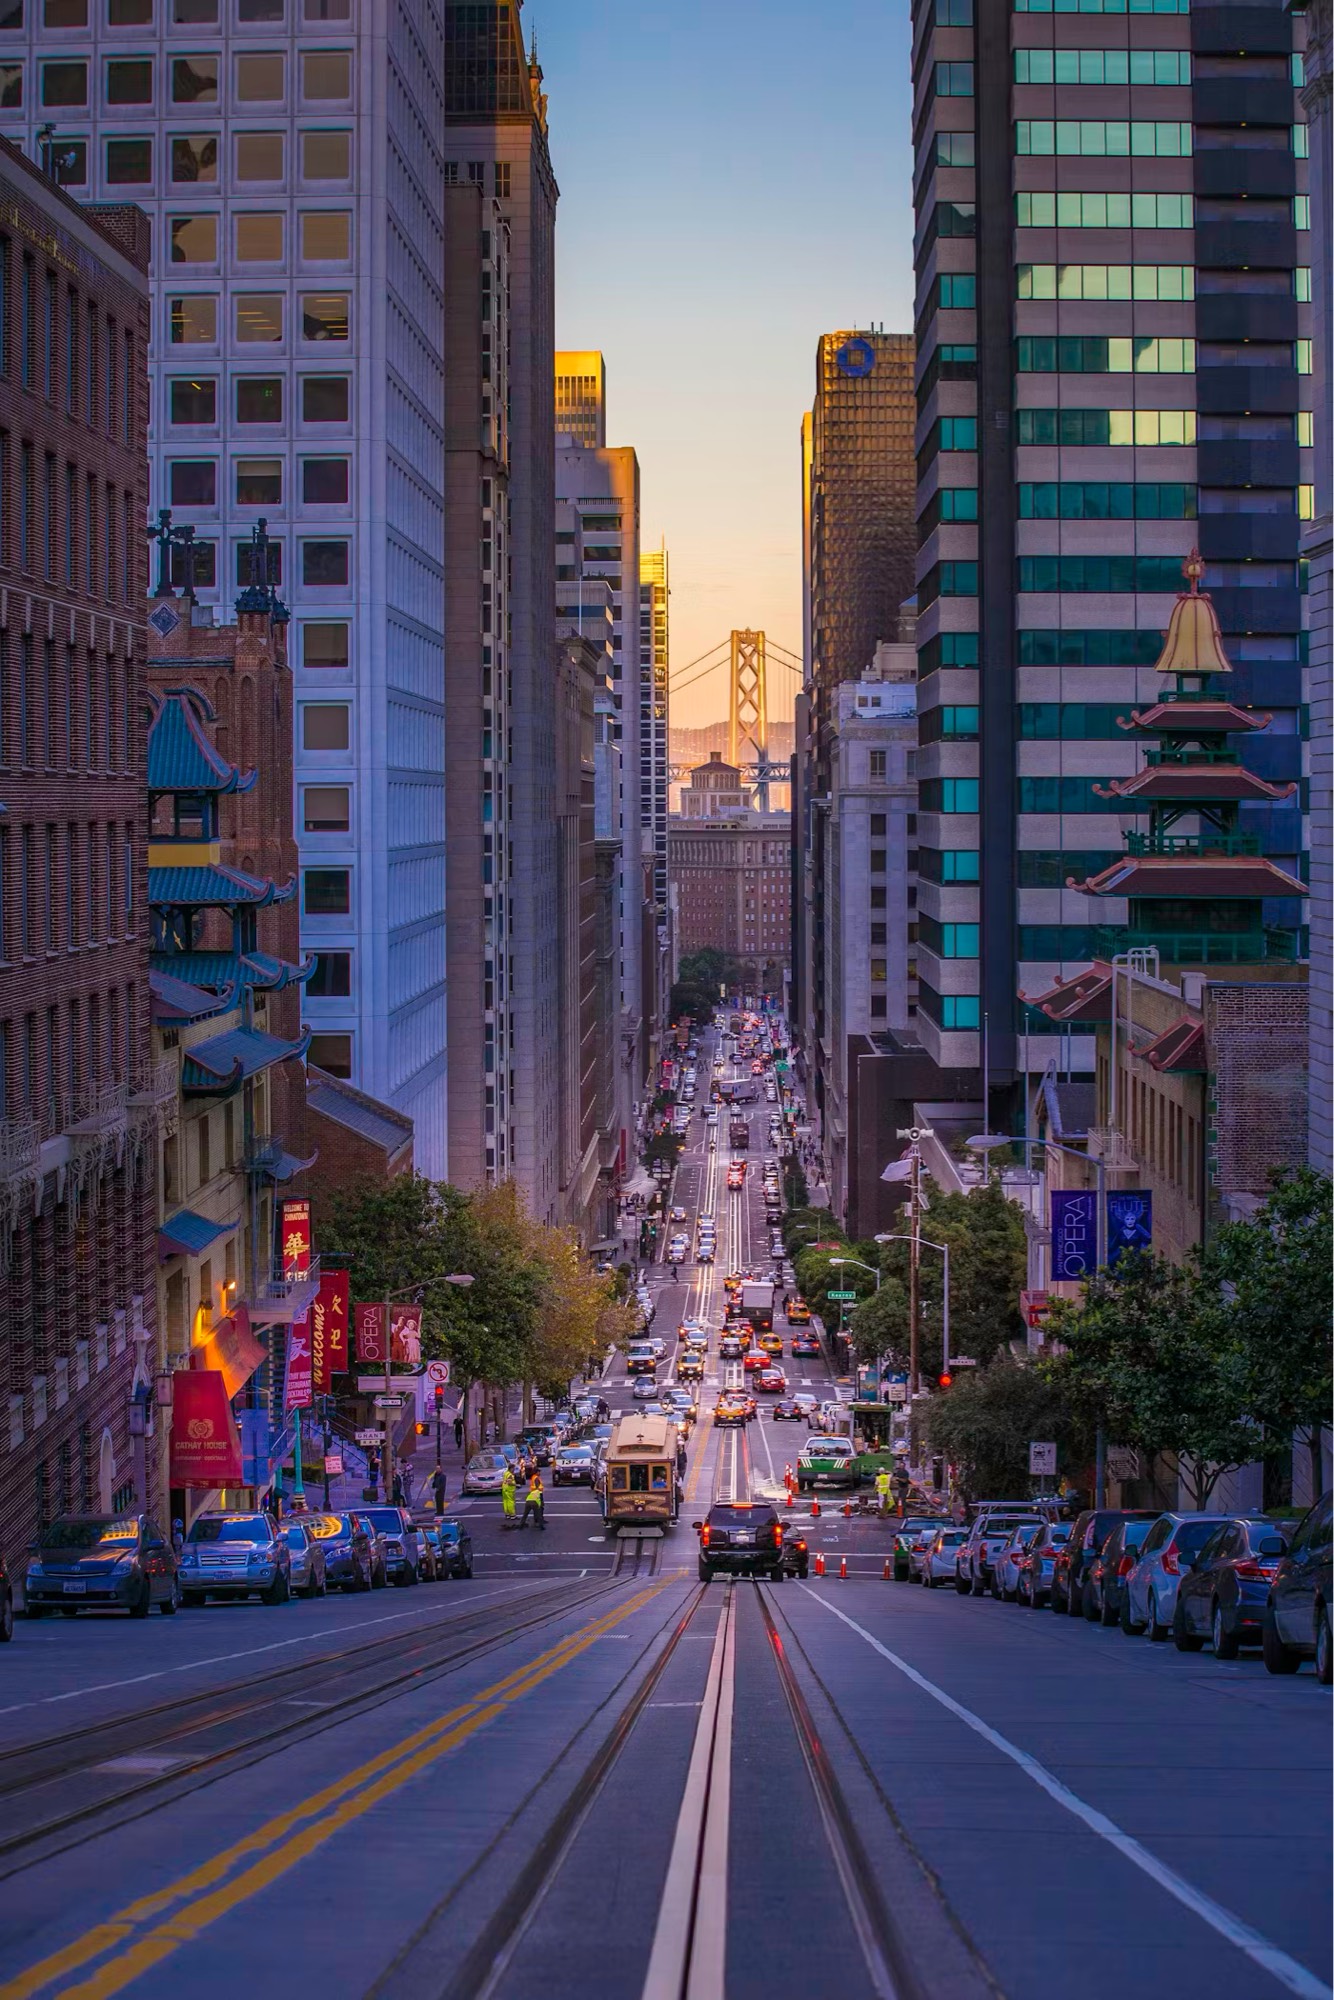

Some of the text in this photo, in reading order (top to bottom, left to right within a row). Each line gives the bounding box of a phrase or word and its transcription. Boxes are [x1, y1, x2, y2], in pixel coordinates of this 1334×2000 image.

[283, 1204, 303, 1212] WELCOME
[284, 1212, 309, 1221] CHINATOWN
[1063, 1196, 1086, 1277] OPERA
[283, 1232, 310, 1260] 華
[363, 1306, 379, 1360] OPERA
[175, 1441, 227, 1450] CATHAY HOUSE
